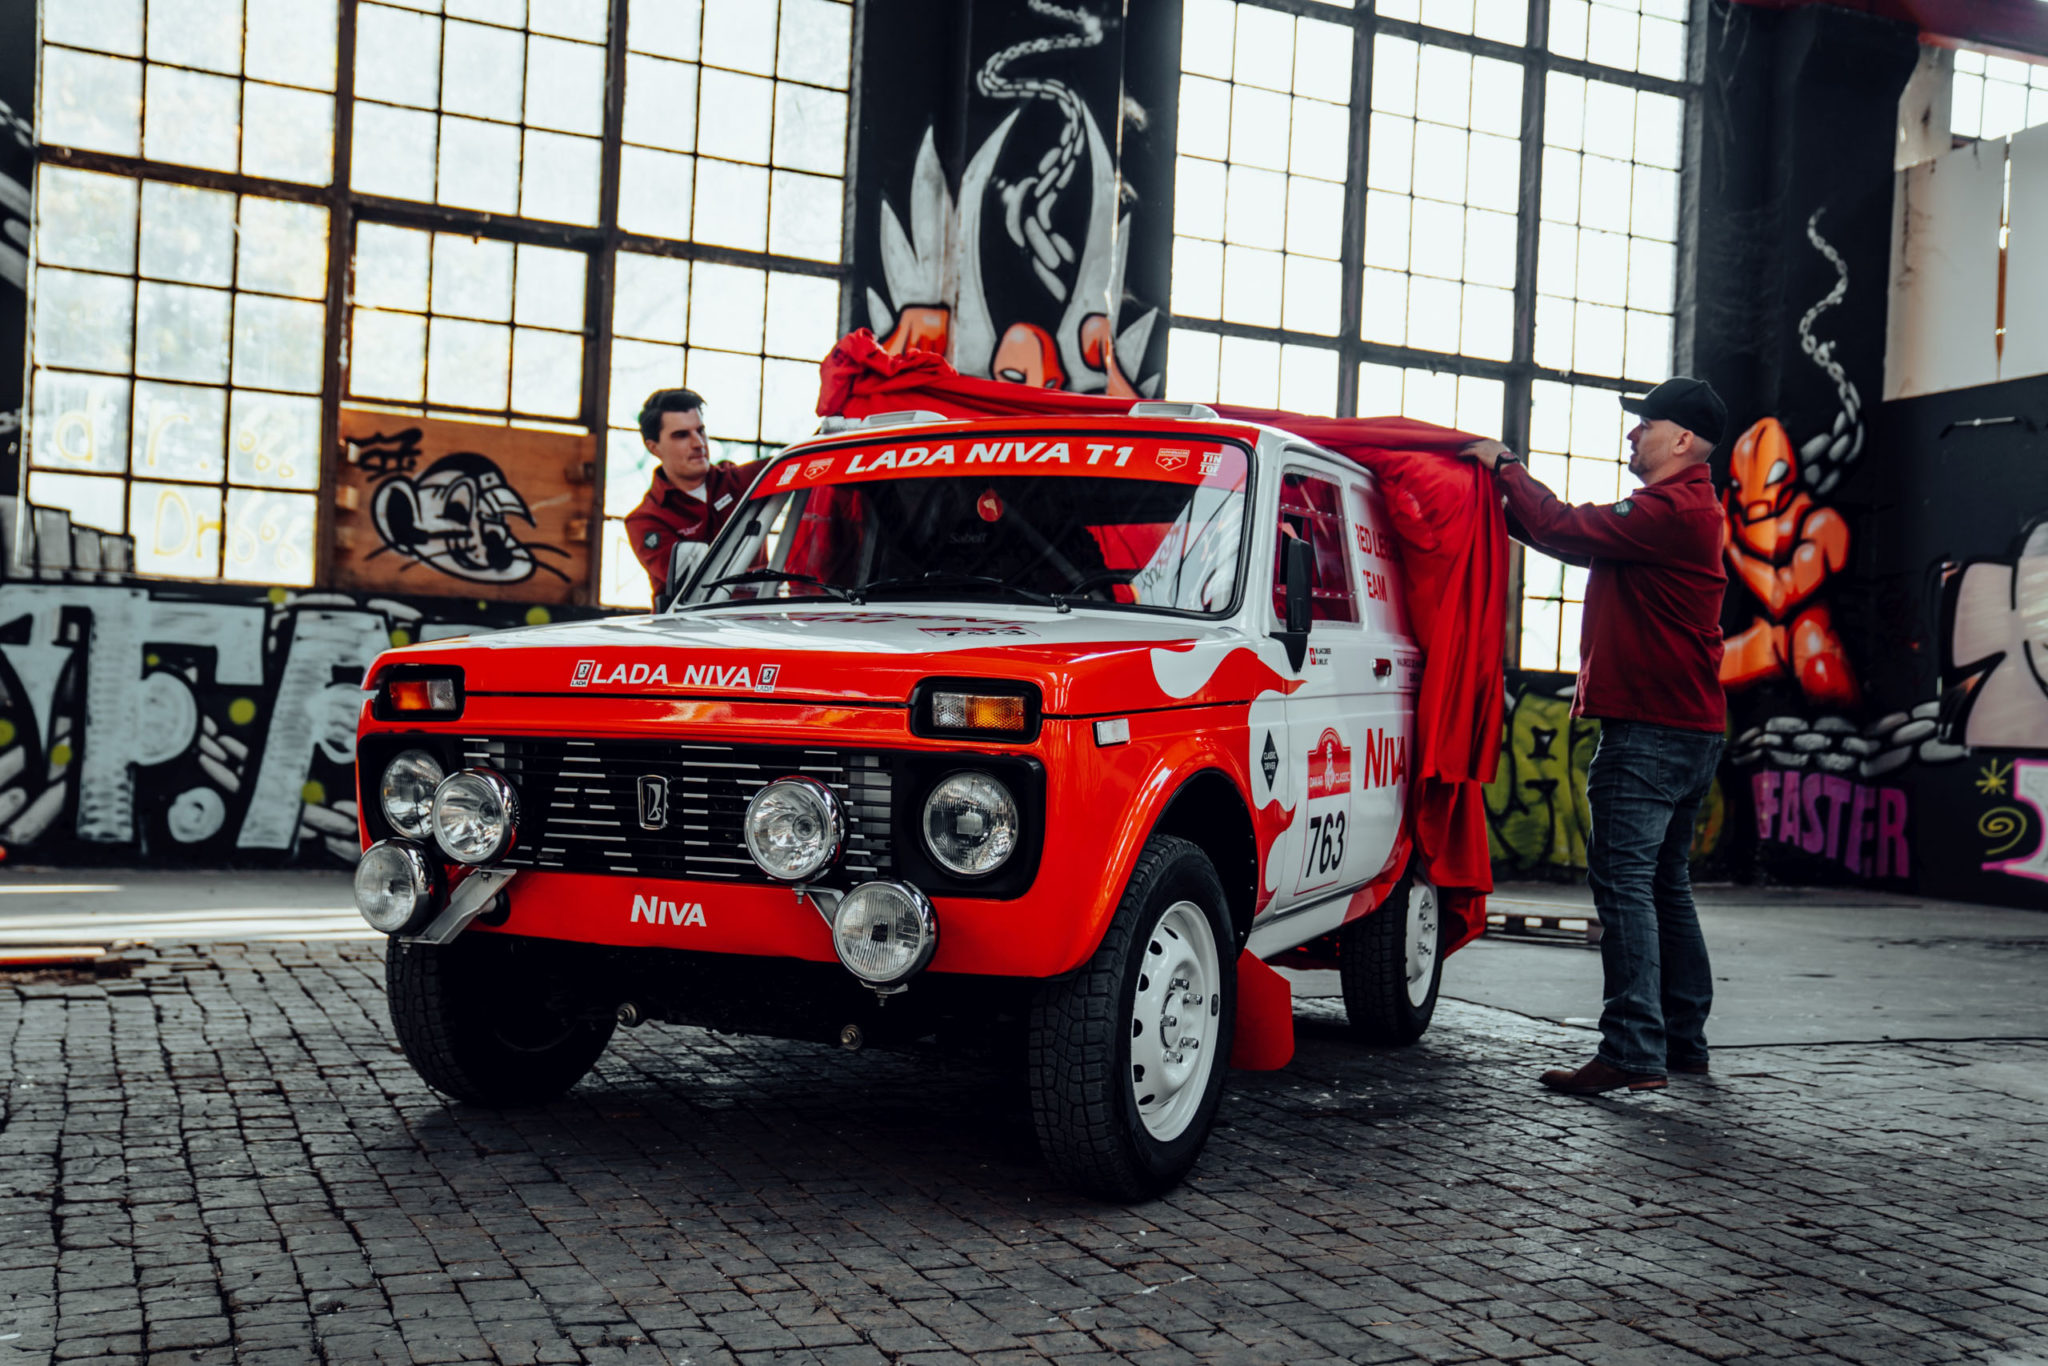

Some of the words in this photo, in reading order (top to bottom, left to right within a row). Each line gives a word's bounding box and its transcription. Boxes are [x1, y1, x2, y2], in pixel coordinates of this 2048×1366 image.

[845, 445, 955, 475] LADA
[964, 441, 1075, 466] NIVA
[1086, 443, 1135, 467] T1
[1202, 453, 1222, 464] TIN
[591, 663, 669, 684] LADA
[683, 664, 752, 688] NIVA
[1363, 727, 1408, 791] NIVA
[1751, 770, 1911, 879] FASTER
[1305, 810, 1346, 879] 763
[630, 895, 707, 928] NIVA
